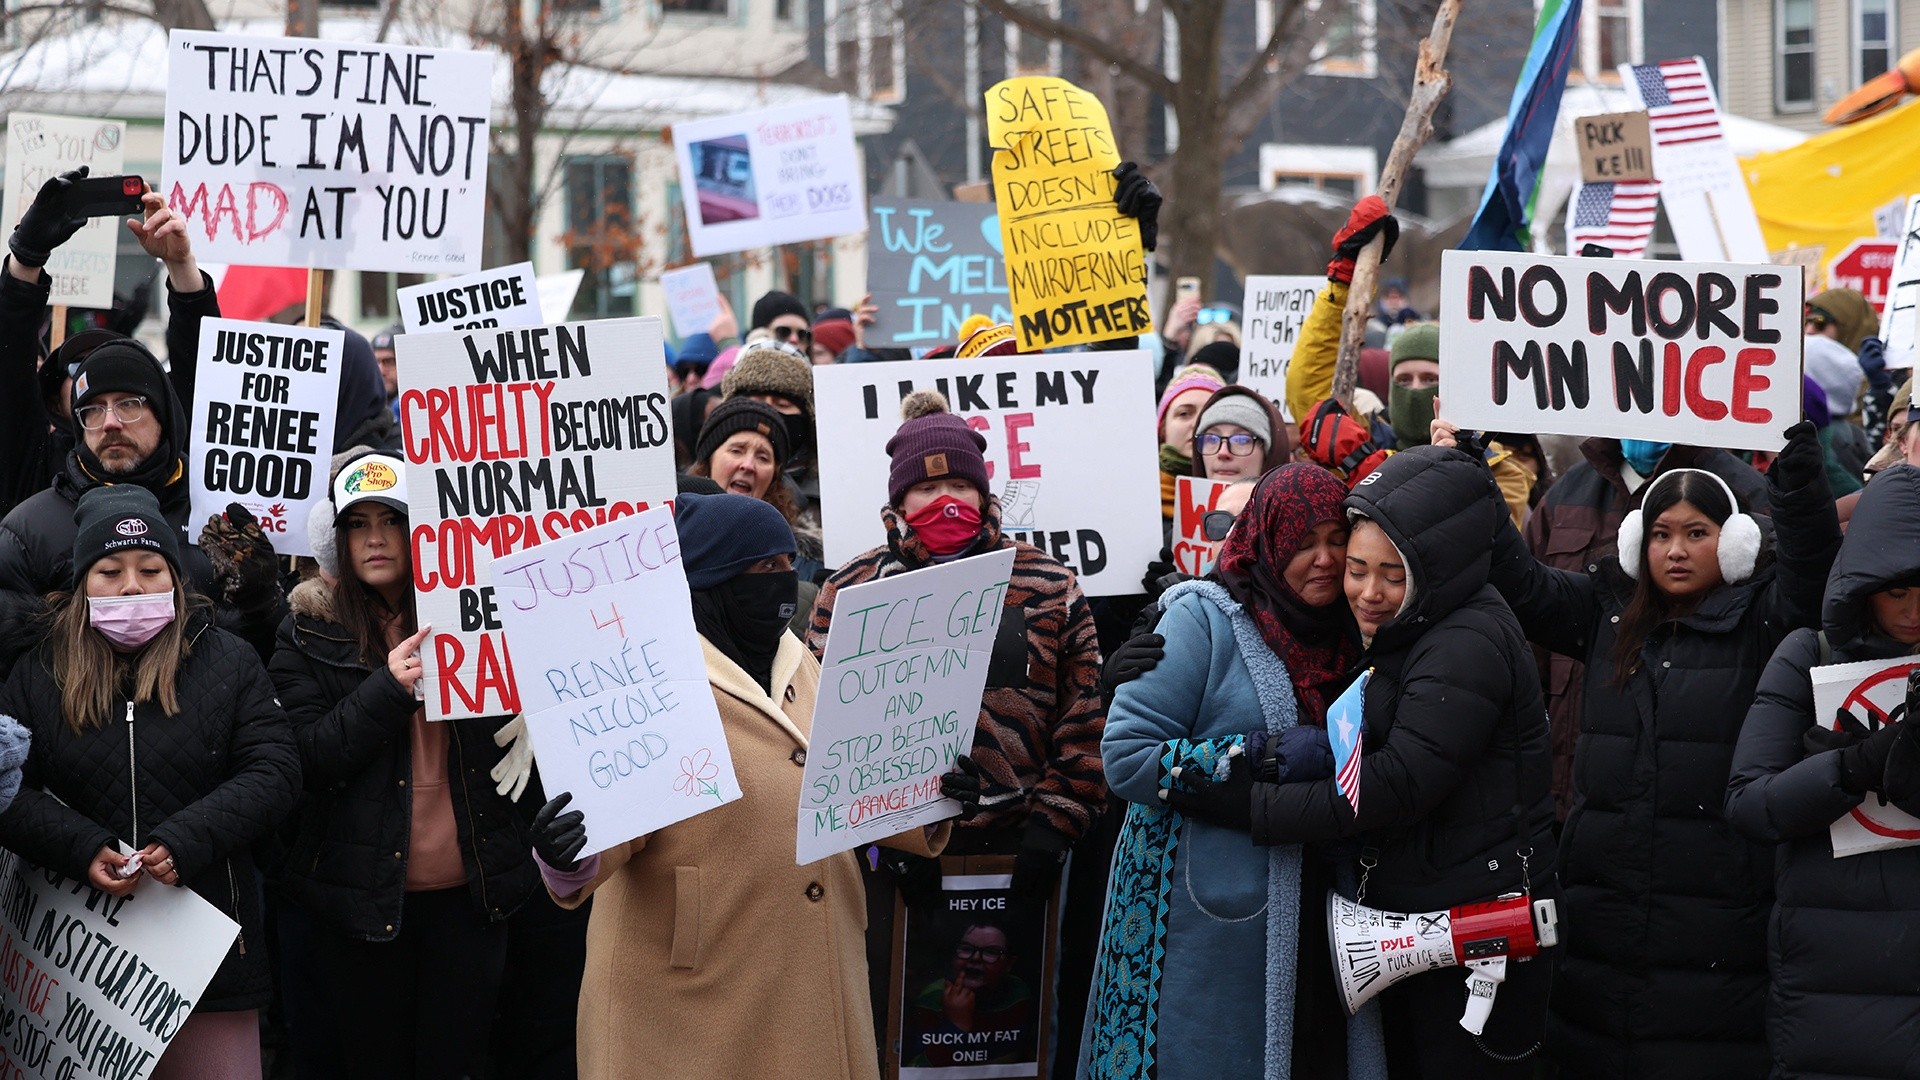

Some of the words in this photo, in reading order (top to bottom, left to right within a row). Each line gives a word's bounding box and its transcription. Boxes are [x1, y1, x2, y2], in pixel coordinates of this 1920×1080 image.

[999, 86, 1088, 123] SAFE
[53, 132, 95, 163] YOU
[297, 111, 369, 173] I'M
[386, 113, 486, 180] NOT
[1003, 127, 1113, 171] STREETS
[167, 180, 289, 245] MAD
[300, 185, 356, 239] AT
[806, 183, 851, 210] DOGS
[1007, 169, 1114, 211] DOESN'T
[873, 206, 953, 254] We
[1010, 215, 1132, 255] INCLUDE
[907, 254, 1009, 295] MEL
[1011, 250, 1142, 304] MURDERING
[416, 275, 527, 326] JUSTICE
[1020, 294, 1150, 347] MOTHERS
[1467, 263, 1567, 328] NO
[1586, 269, 1782, 344] MORE
[212, 329, 330, 374] JUSTICE
[462, 325, 592, 384] WHEN
[241, 371, 290, 404] FOR
[863, 384, 878, 419] I
[1035, 369, 1100, 407] MY
[1491, 338, 1590, 411] MN
[1611, 337, 1777, 424] NICE
[205, 401, 320, 454] RENEE
[400, 381, 555, 465] CRUELTY
[551, 392, 668, 452] BECOMES
[203, 448, 313, 500] GOOD
[366, 463, 388, 472] Bass
[366, 478, 392, 487] Shops
[435, 455, 606, 519] NORMAL
[104, 538, 138, 550] Schwartz
[140, 538, 161, 549] Farms
[503, 523, 681, 611] JUSTICE
[589, 602, 625, 638] 4
[946, 581, 1010, 639] GET
[838, 660, 897, 704] OUT
[894, 654, 922, 684] OF
[924, 644, 970, 684] MN
[569, 680, 680, 746] NICOLE
[884, 691, 923, 722] AND
[588, 731, 668, 789] GOOD
[822, 733, 882, 770] STOP
[892, 710, 959, 754] BEING
[811, 773, 840, 804] SO
[849, 747, 937, 795] OBSESSED
[848, 786, 912, 825] ORANGE
[949, 899, 979, 911] HEY
[982, 897, 1006, 910] ICE
[1346, 940, 1381, 993] VOTE!
[1380, 936, 1415, 952] PYLE
[1387, 953, 1415, 972] FUCK
[1416, 949, 1433, 964] ICE
[922, 1033, 964, 1045] SUCK
[967, 1031, 991, 1044] MY
[994, 1029, 1020, 1042] FAT
[952, 1050, 988, 1062] ONE!
